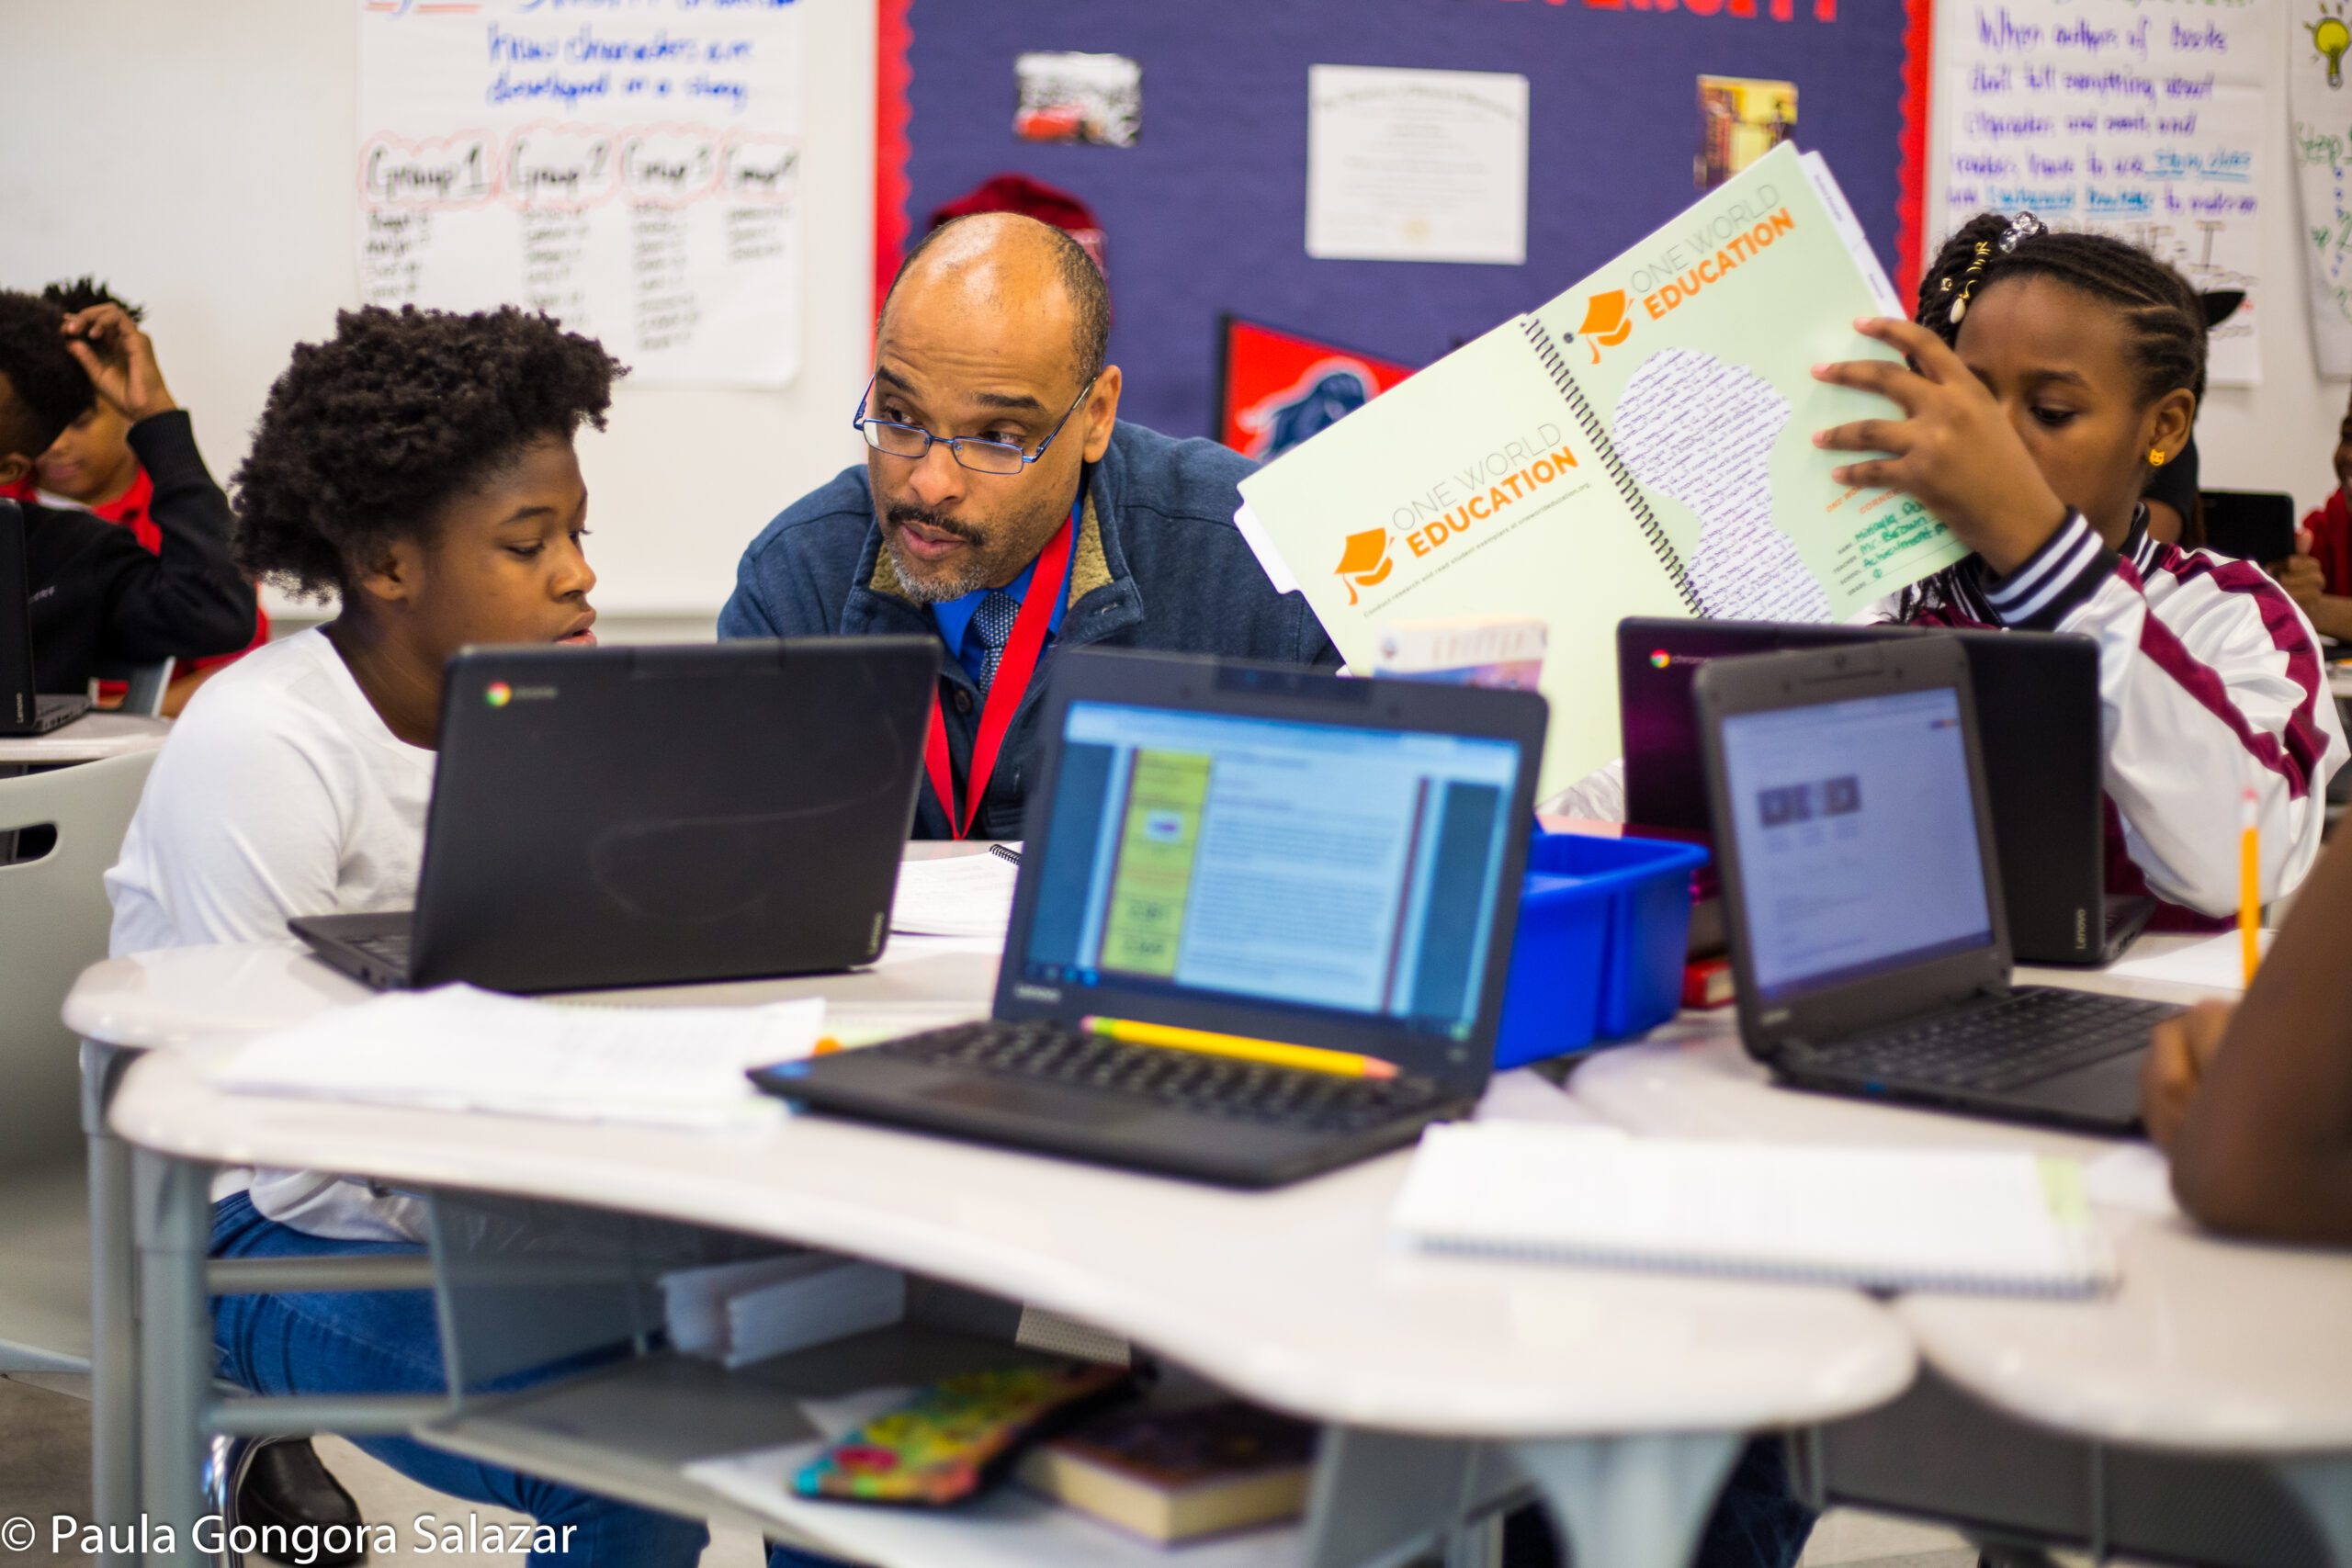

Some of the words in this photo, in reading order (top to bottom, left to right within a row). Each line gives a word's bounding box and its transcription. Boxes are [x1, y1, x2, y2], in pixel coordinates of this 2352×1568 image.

[1631, 244, 1689, 292] ONE
[1685, 185, 1779, 254] WORLD
[1643, 208, 1794, 320] EDUCATION
[1393, 481, 1456, 531] ONE
[1453, 423, 1561, 491] WORLD
[1405, 446, 1578, 558] EDUCATION
[1421, 570, 1433, 581] and
